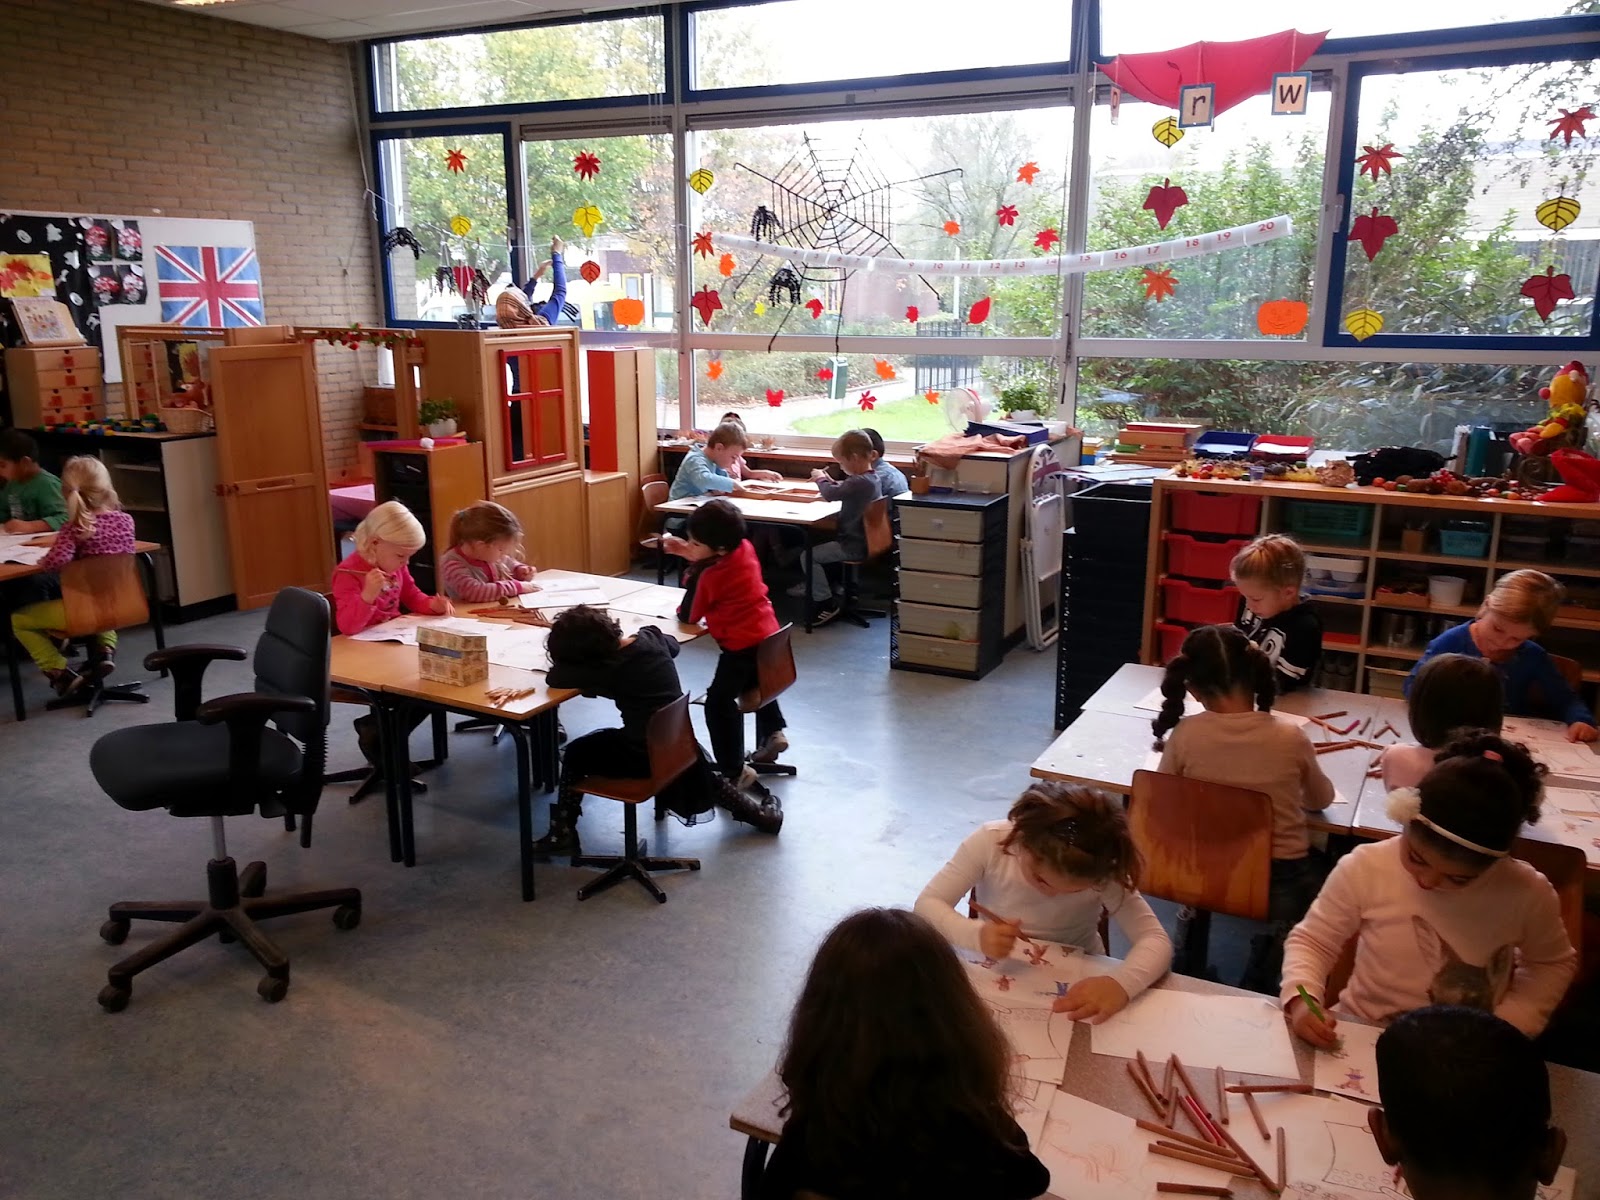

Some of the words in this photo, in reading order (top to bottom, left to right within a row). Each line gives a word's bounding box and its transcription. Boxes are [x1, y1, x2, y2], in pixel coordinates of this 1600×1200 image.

[1192, 95, 1207, 117] r
[933, 262, 944, 270] 10
[1014, 261, 1026, 269] 13
[1079, 254, 1092, 262] 15
[1114, 251, 1128, 260] 16
[1147, 245, 1161, 255] 17
[1185, 238, 1200, 247] 18
[1216, 231, 1232, 242] 19
[1258, 221, 1275, 233] 20
